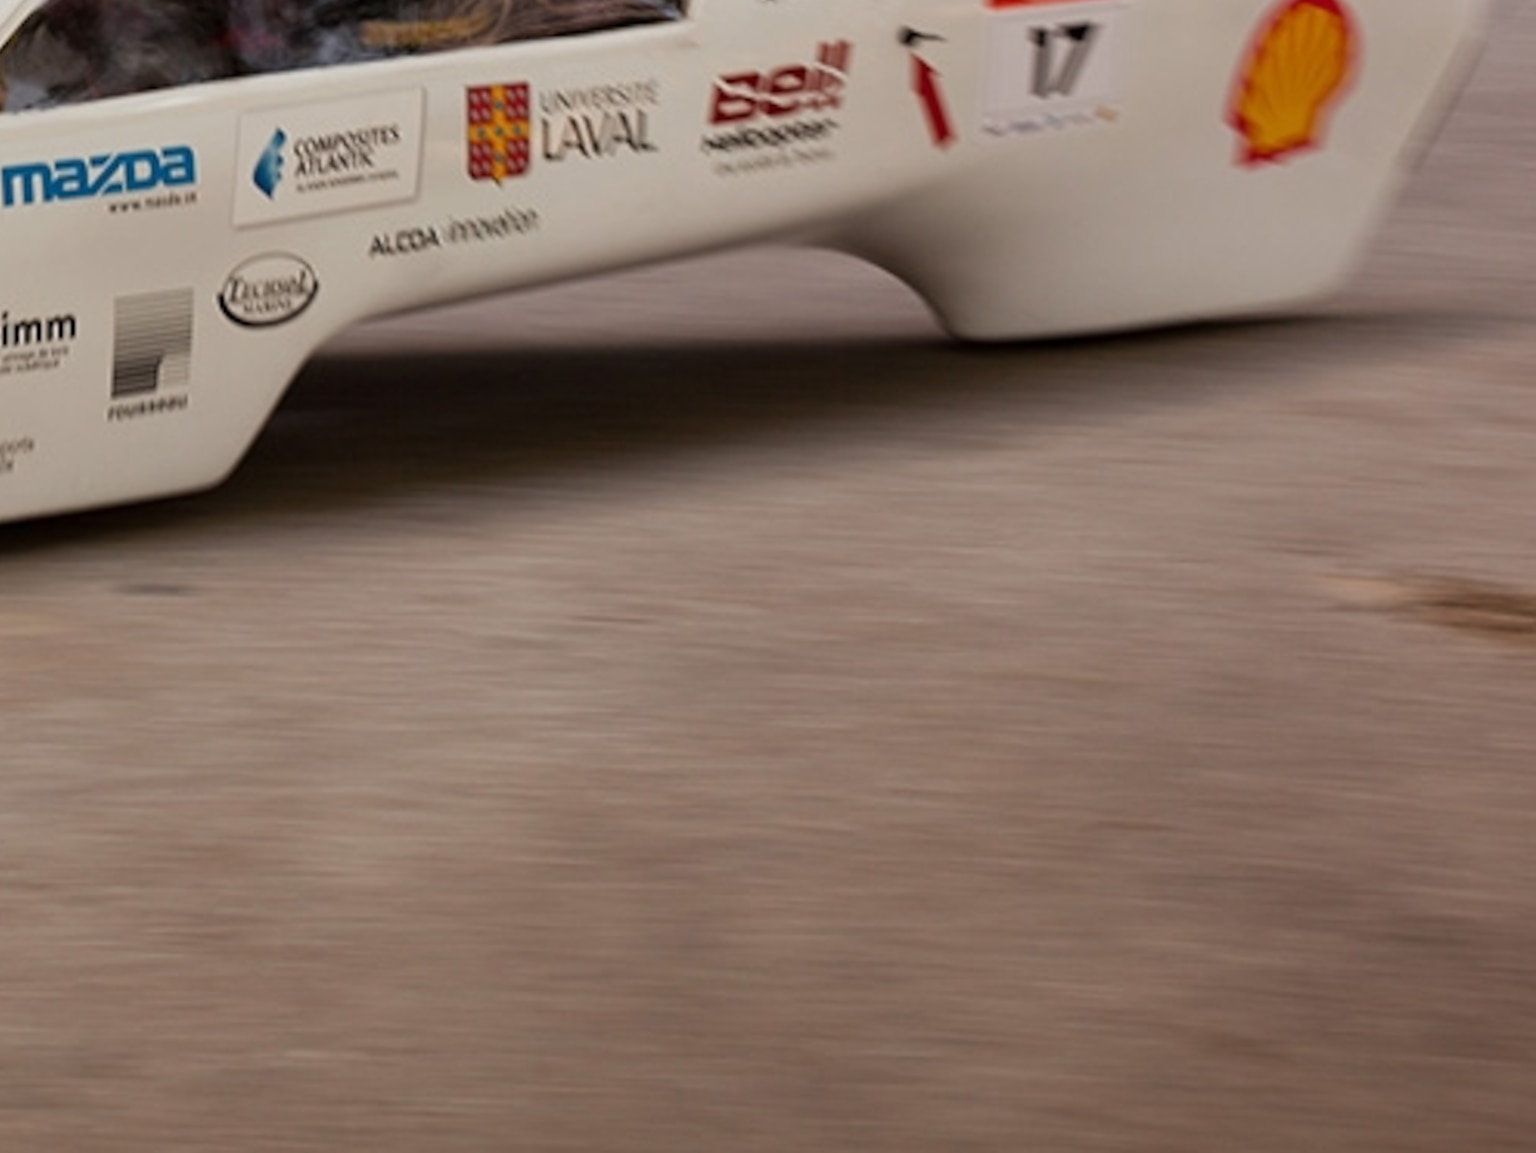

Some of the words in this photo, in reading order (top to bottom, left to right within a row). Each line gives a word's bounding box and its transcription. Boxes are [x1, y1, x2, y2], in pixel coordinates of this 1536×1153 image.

[710, 38, 851, 124] Bell
[1028, 21, 1104, 99] 17
[541, 108, 659, 161] LAVAL
[368, 226, 441, 258] ALCOA
